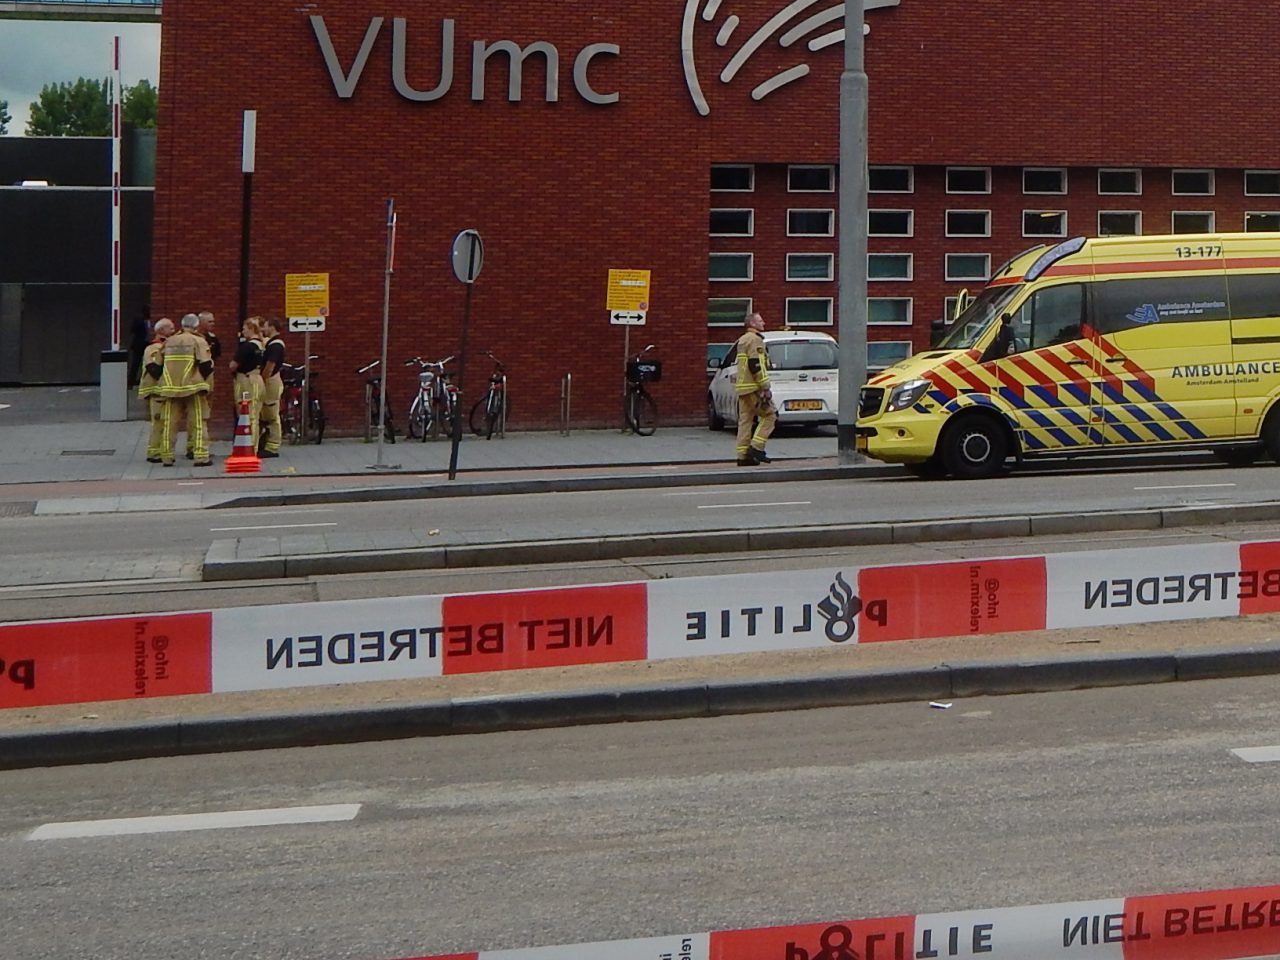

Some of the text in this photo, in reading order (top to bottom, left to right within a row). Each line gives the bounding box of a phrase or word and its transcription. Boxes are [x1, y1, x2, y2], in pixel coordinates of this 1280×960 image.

[309, 15, 620, 104] VUmc
[1175, 246, 1222, 258] 13-177
[1171, 361, 1280, 378] AMBULANCE
